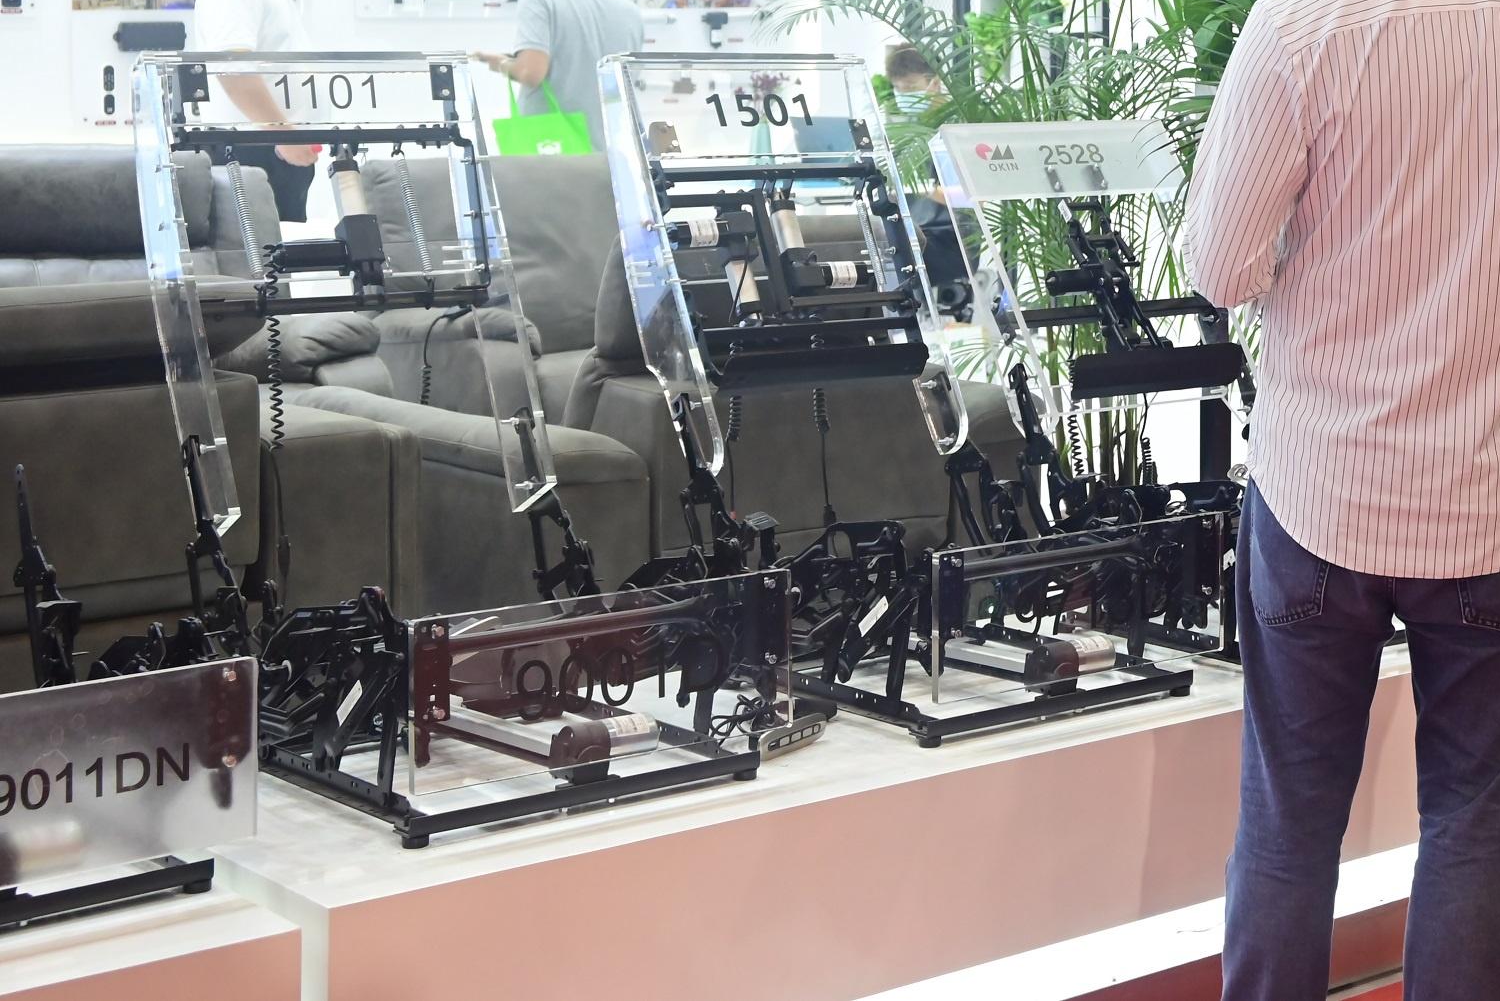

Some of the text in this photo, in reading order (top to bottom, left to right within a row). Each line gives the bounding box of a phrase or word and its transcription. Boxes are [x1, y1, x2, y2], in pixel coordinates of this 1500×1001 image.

[274, 74, 377, 109] 1101
[705, 93, 813, 127] 1501
[988, 162, 1019, 172] OKIN
[1038, 143, 1105, 166] 2528
